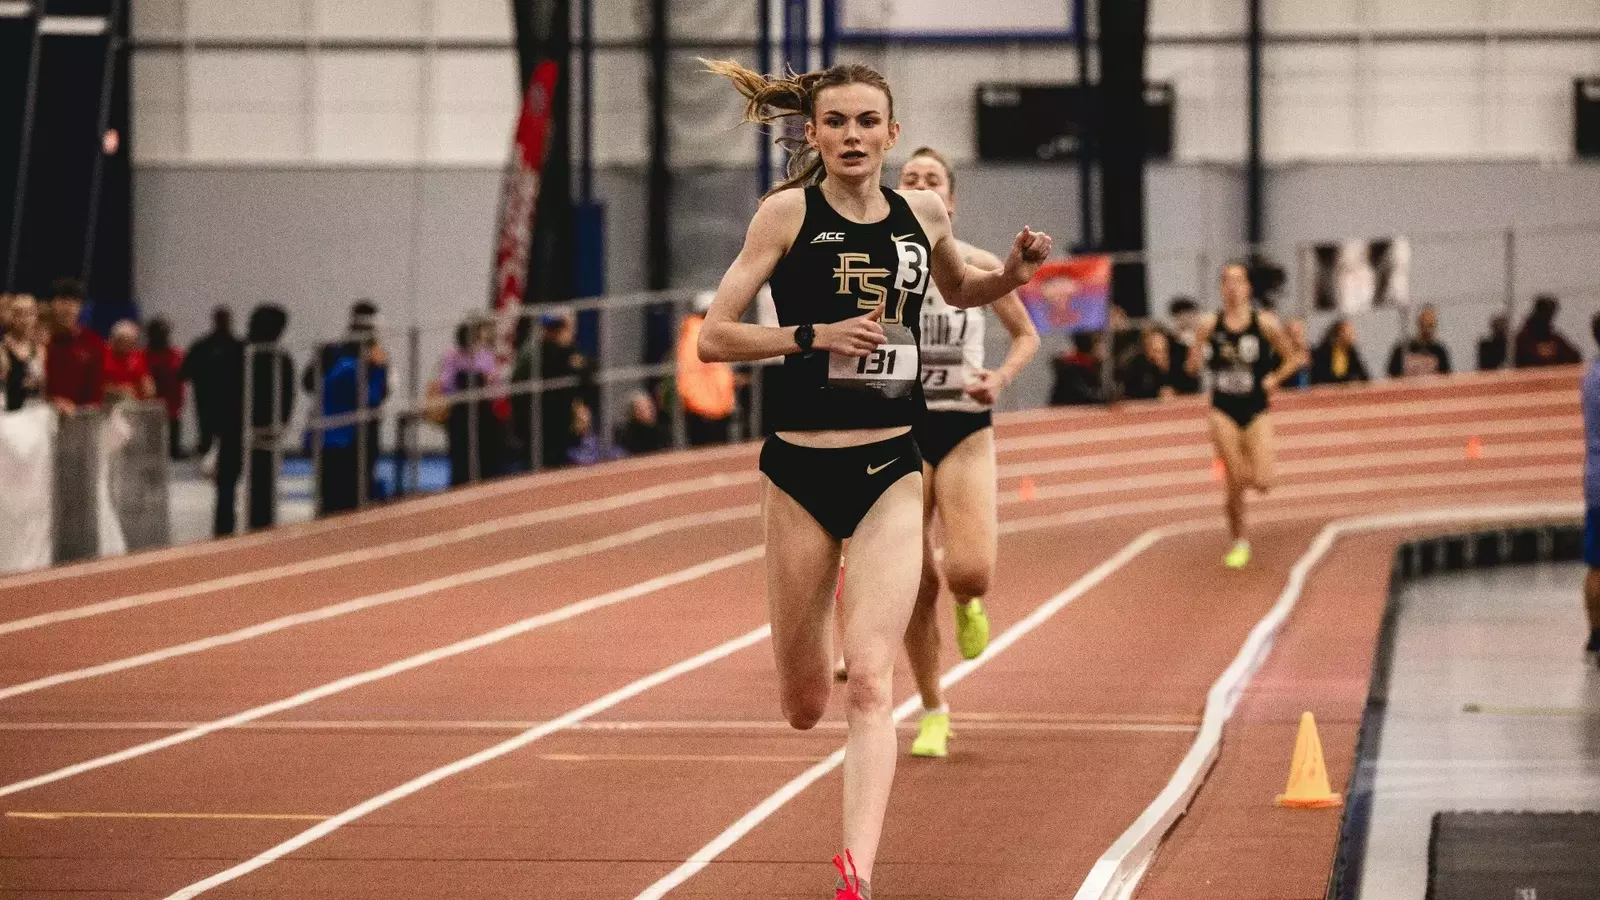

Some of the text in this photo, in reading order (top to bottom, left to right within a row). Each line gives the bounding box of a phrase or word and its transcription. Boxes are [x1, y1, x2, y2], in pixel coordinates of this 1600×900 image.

[811, 231, 846, 244] ACC
[901, 244, 922, 290] 3
[856, 349, 897, 375] 131
